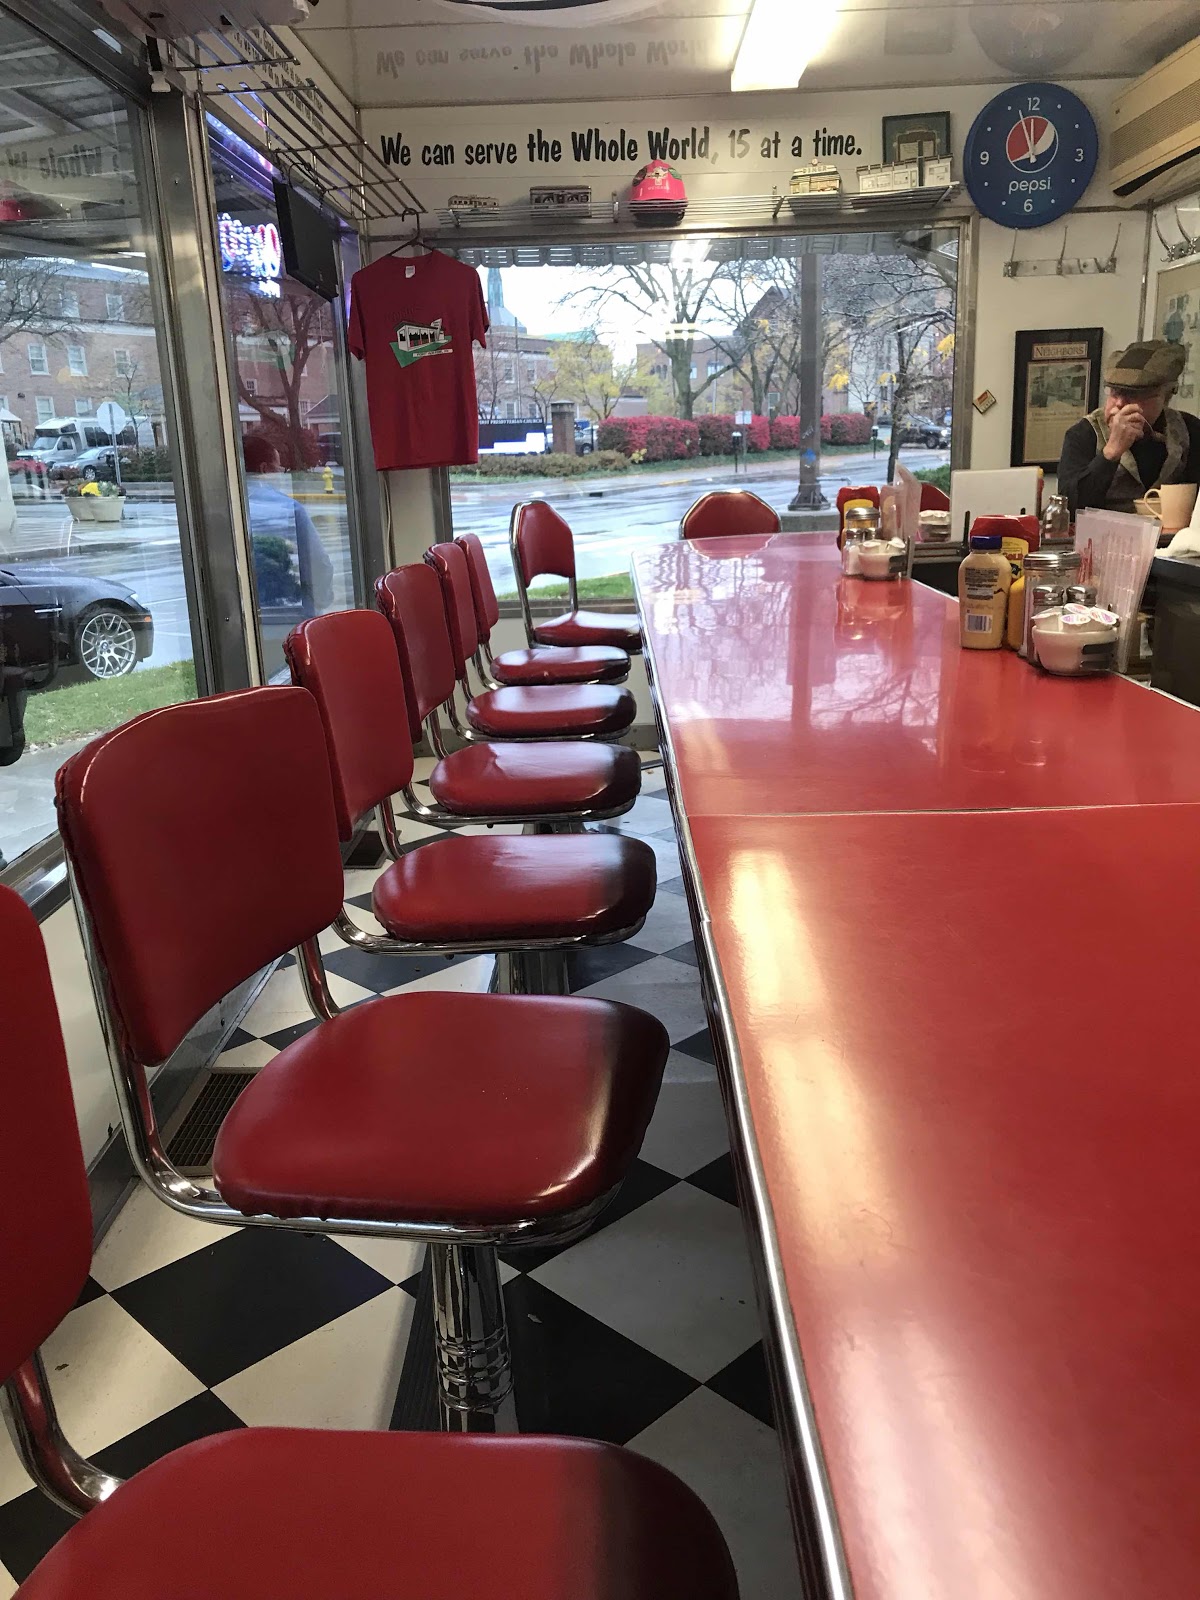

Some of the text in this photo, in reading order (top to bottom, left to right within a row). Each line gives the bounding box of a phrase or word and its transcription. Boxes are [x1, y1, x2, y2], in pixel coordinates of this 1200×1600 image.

[1027, 97, 1041, 111] 12
[380, 126, 862, 166] We can serve the Whole World, 15 at a time.
[980, 151, 990, 166] 9
[1074, 148, 1084, 162] 3
[1008, 176, 1052, 194] pepsi
[1023, 198, 1033, 212] 6
[1035, 346, 1085, 357] NEIGHBORS
